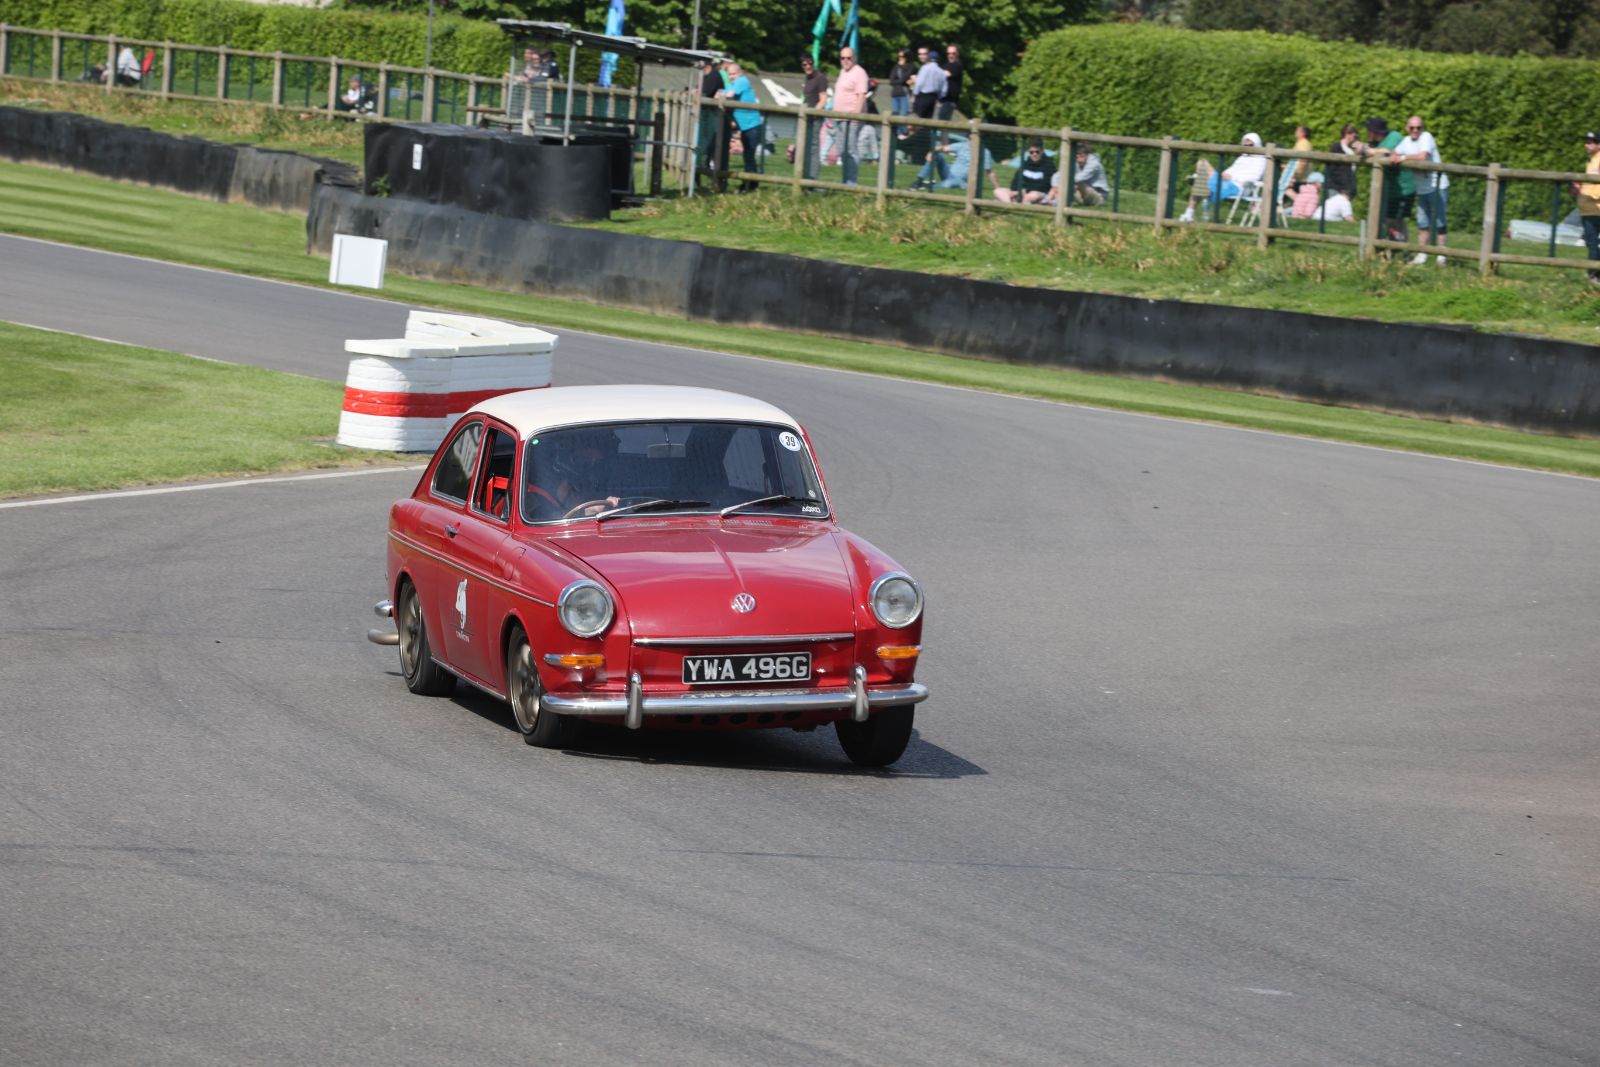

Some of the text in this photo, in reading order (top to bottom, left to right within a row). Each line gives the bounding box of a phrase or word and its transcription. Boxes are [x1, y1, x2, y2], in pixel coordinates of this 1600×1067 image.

[733, 593, 756, 612] VW
[686, 656, 808, 681] YWA 496G
